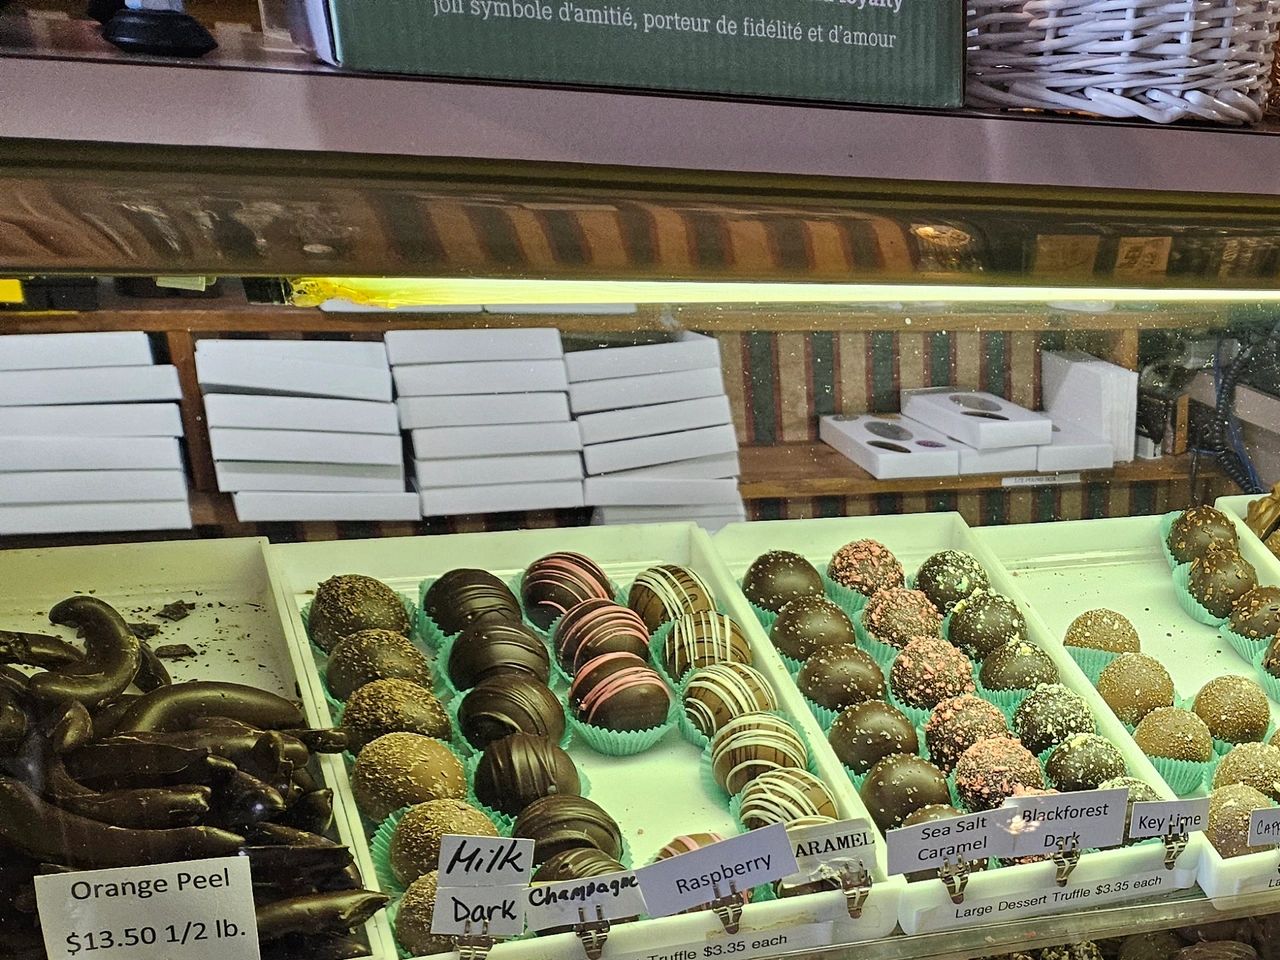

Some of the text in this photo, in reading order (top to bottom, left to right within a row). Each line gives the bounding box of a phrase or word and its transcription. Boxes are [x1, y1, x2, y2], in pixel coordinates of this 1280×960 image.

[470, 0, 553, 20] symbole
[558, 2, 637, 29] d'amitié,
[643, 12, 711, 33] porteur
[716, 15, 738, 35] de
[743, 17, 802, 40] fidélité
[808, 25, 823, 42] et
[1022, 803, 1109, 822] Blackforest
[1139, 815, 1165, 831] Key
[921, 816, 987, 840] Sea Salt
[1044, 831, 1081, 847] Dark
[446, 839, 524, 875] Milk
[795, 831, 875, 858] ARAMEL
[917, 836, 988, 862] Caramel
[71, 868, 230, 900] Orange Peel
[676, 854, 771, 894] Raspberry
[528, 875, 639, 906] Champagne
[955, 875, 1162, 919] Large Dessert Truffle $3.35 each
[451, 896, 517, 923] Dark
[66, 918, 246, 955] $13.50 1/2 lb.
[703, 940, 746, 958] $3.35
[751, 934, 788, 950] each
